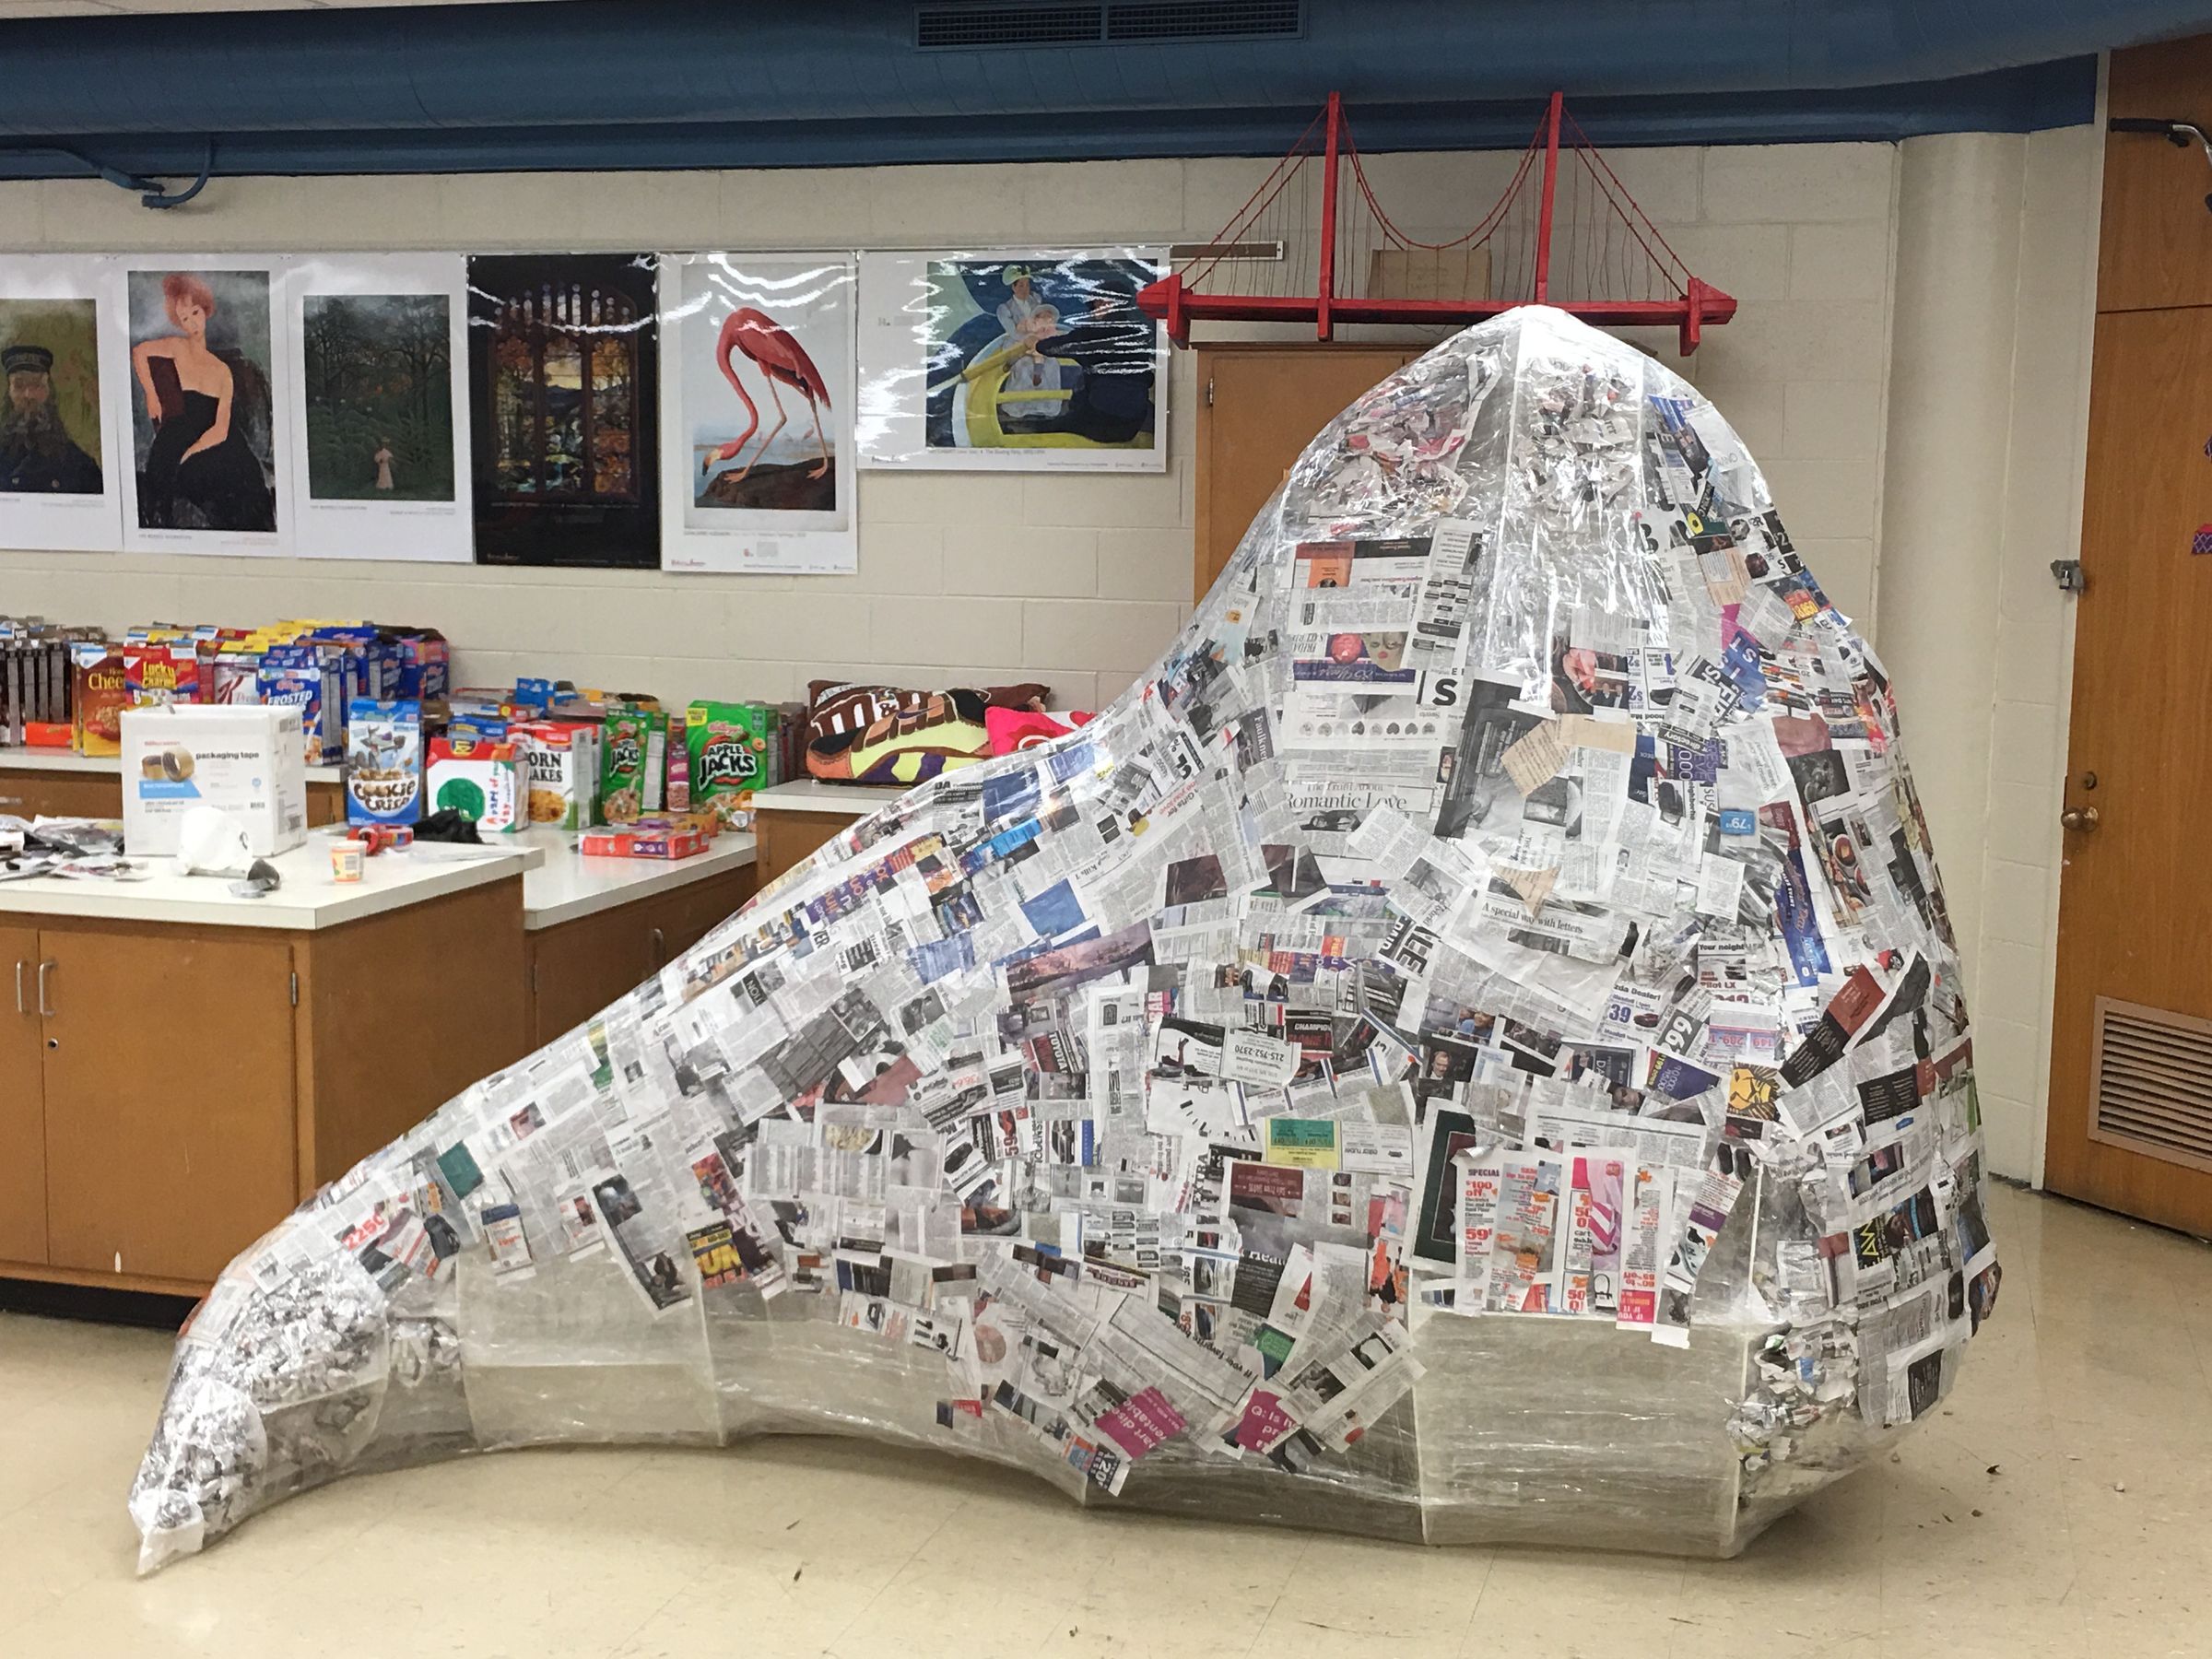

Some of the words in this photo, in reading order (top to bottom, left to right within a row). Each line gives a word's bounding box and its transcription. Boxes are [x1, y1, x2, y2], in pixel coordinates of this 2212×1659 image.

[143, 661, 175, 681] Lucky
[267, 689, 312, 706] FROSTED
[1431, 677, 1459, 707] S
[1253, 715, 1268, 762] Faulkner
[195, 751, 240, 760] packaging
[241, 751, 260, 759] tape
[528, 752, 562, 768] ORN
[709, 743, 743, 757] APPLE
[609, 747, 640, 777] JACKS
[529, 769, 562, 782] AKES
[699, 754, 758, 791] JACKS
[1366, 790, 1407, 810] Love
[1489, 905, 1520, 921] special
[1536, 916, 1556, 929] with
[1557, 919, 1583, 935] letters
[1609, 1004, 1631, 1023] 39
[1048, 1030, 1067, 1070] TOYOTA
[1234, 1044, 1285, 1062] 215-752-2370
[1192, 1152, 1209, 1202] EXTRA
[1467, 1168, 1500, 1178] SPECIAL
